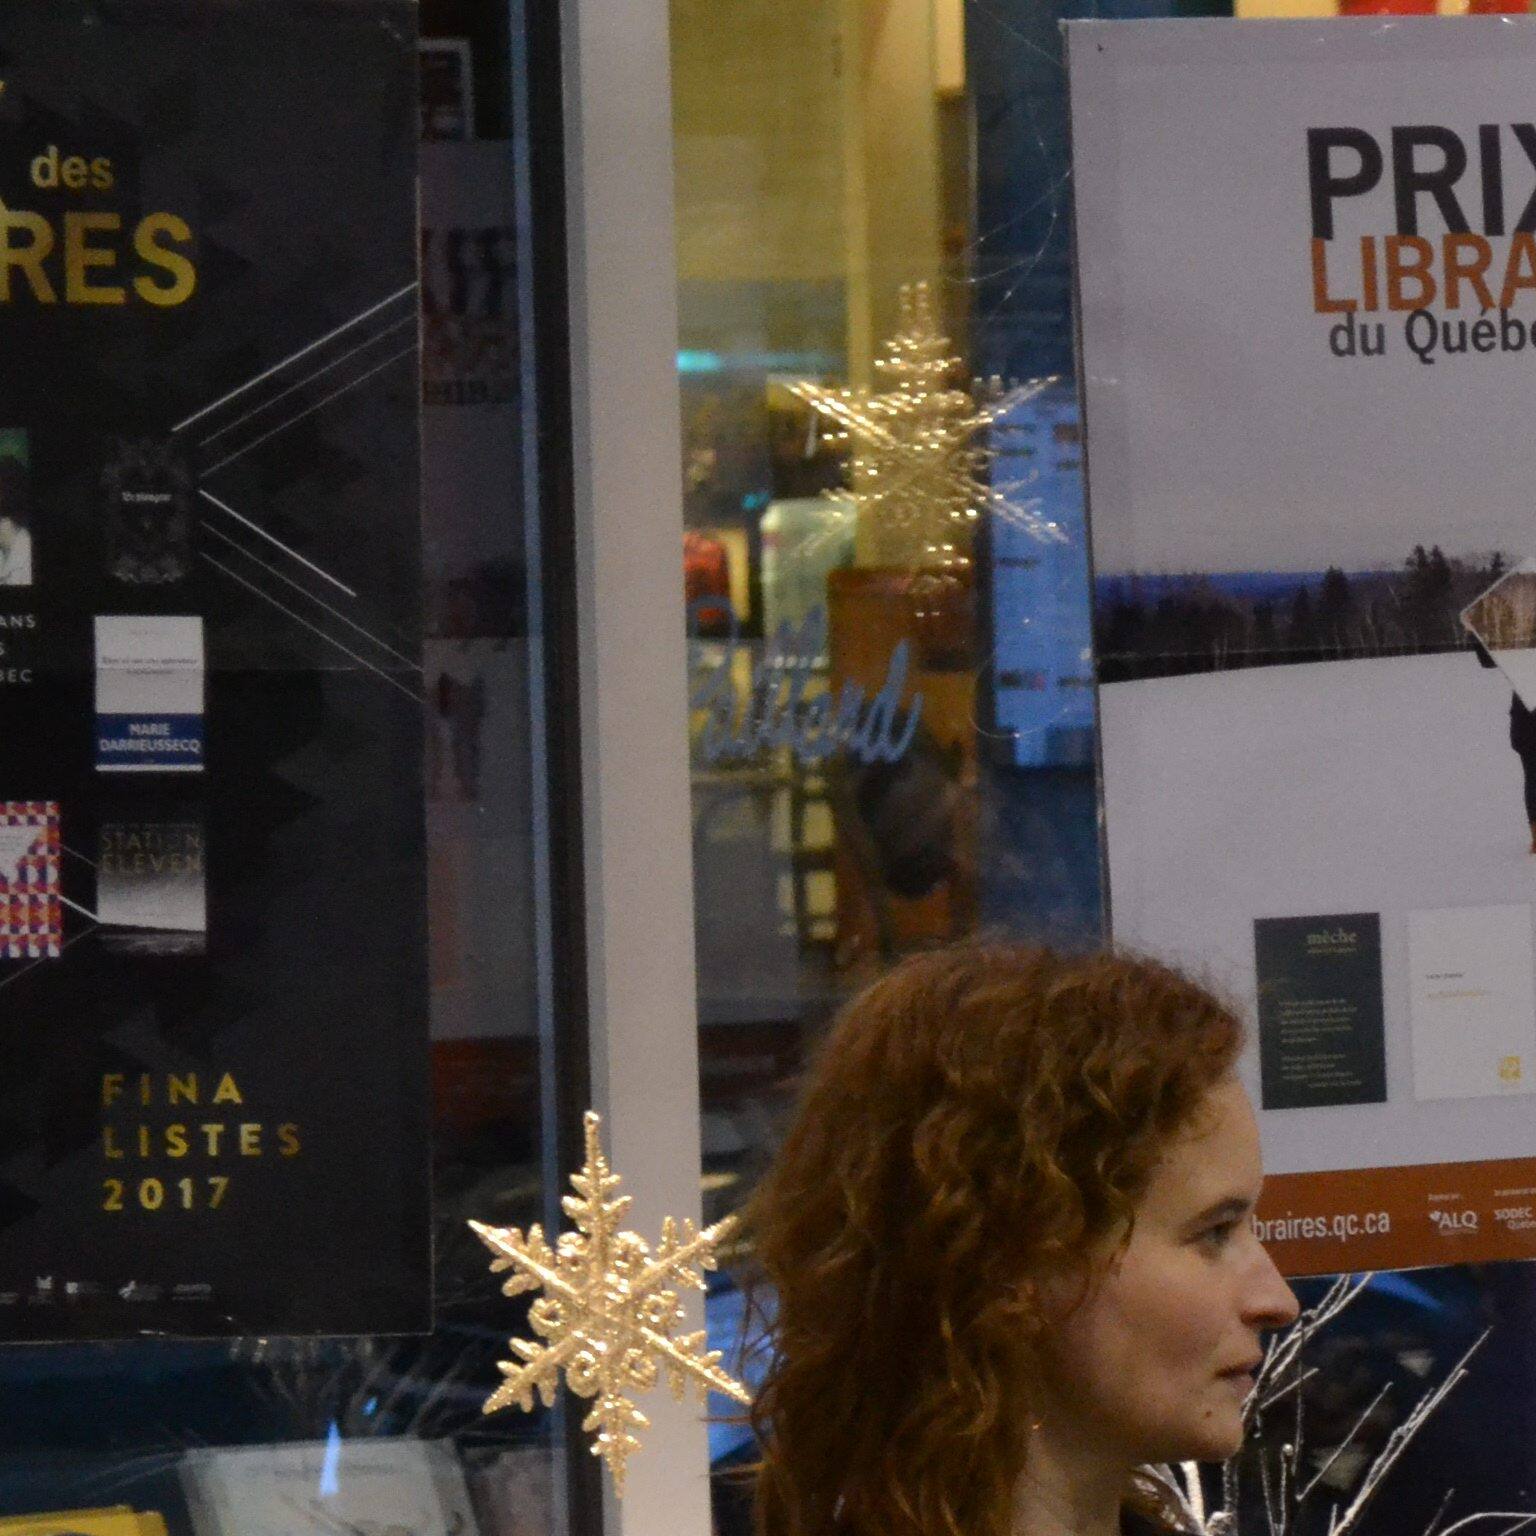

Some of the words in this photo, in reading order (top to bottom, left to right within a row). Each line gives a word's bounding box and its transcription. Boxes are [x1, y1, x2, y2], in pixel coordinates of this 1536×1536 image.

[31, 145, 114, 189] des
[1329, 311, 1386, 356] du
[103, 1072, 244, 1105] FINA
[103, 1123, 303, 1157] LISTES
[102, 1176, 231, 1211] 2017
[1439, 1210, 1478, 1229] ALQ
[1494, 1207, 1533, 1220] SODEC
